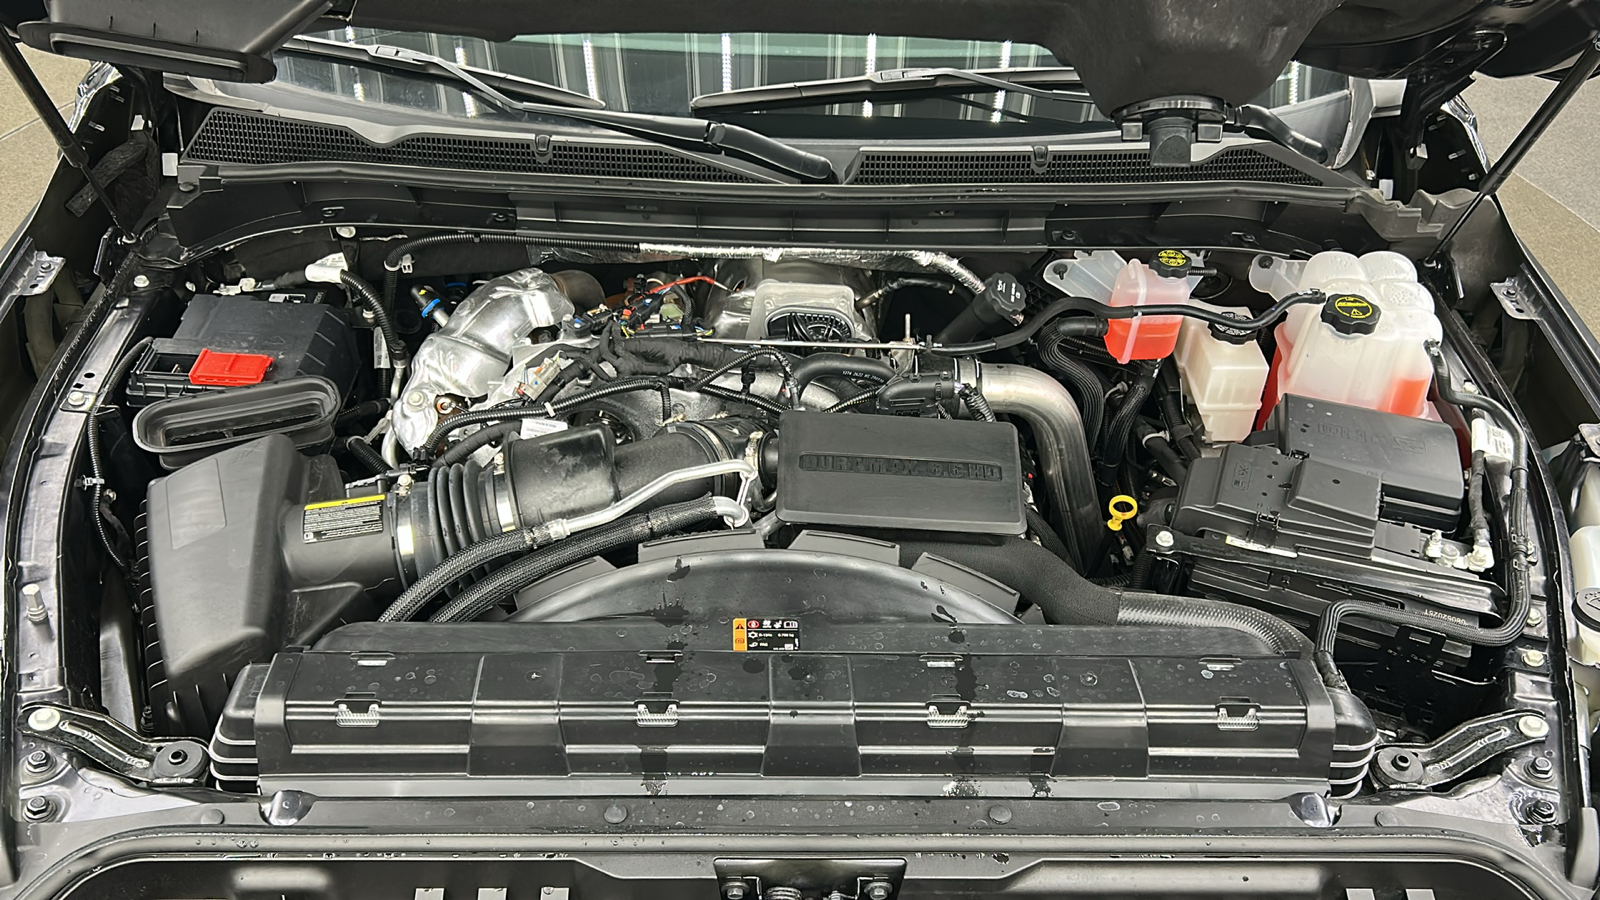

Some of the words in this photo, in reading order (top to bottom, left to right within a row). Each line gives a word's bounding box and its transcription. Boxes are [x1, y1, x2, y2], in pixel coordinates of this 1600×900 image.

[801, 454, 918, 475] DURAMAX
[927, 460, 964, 478] 6.6
[967, 462, 1001, 480] HD
